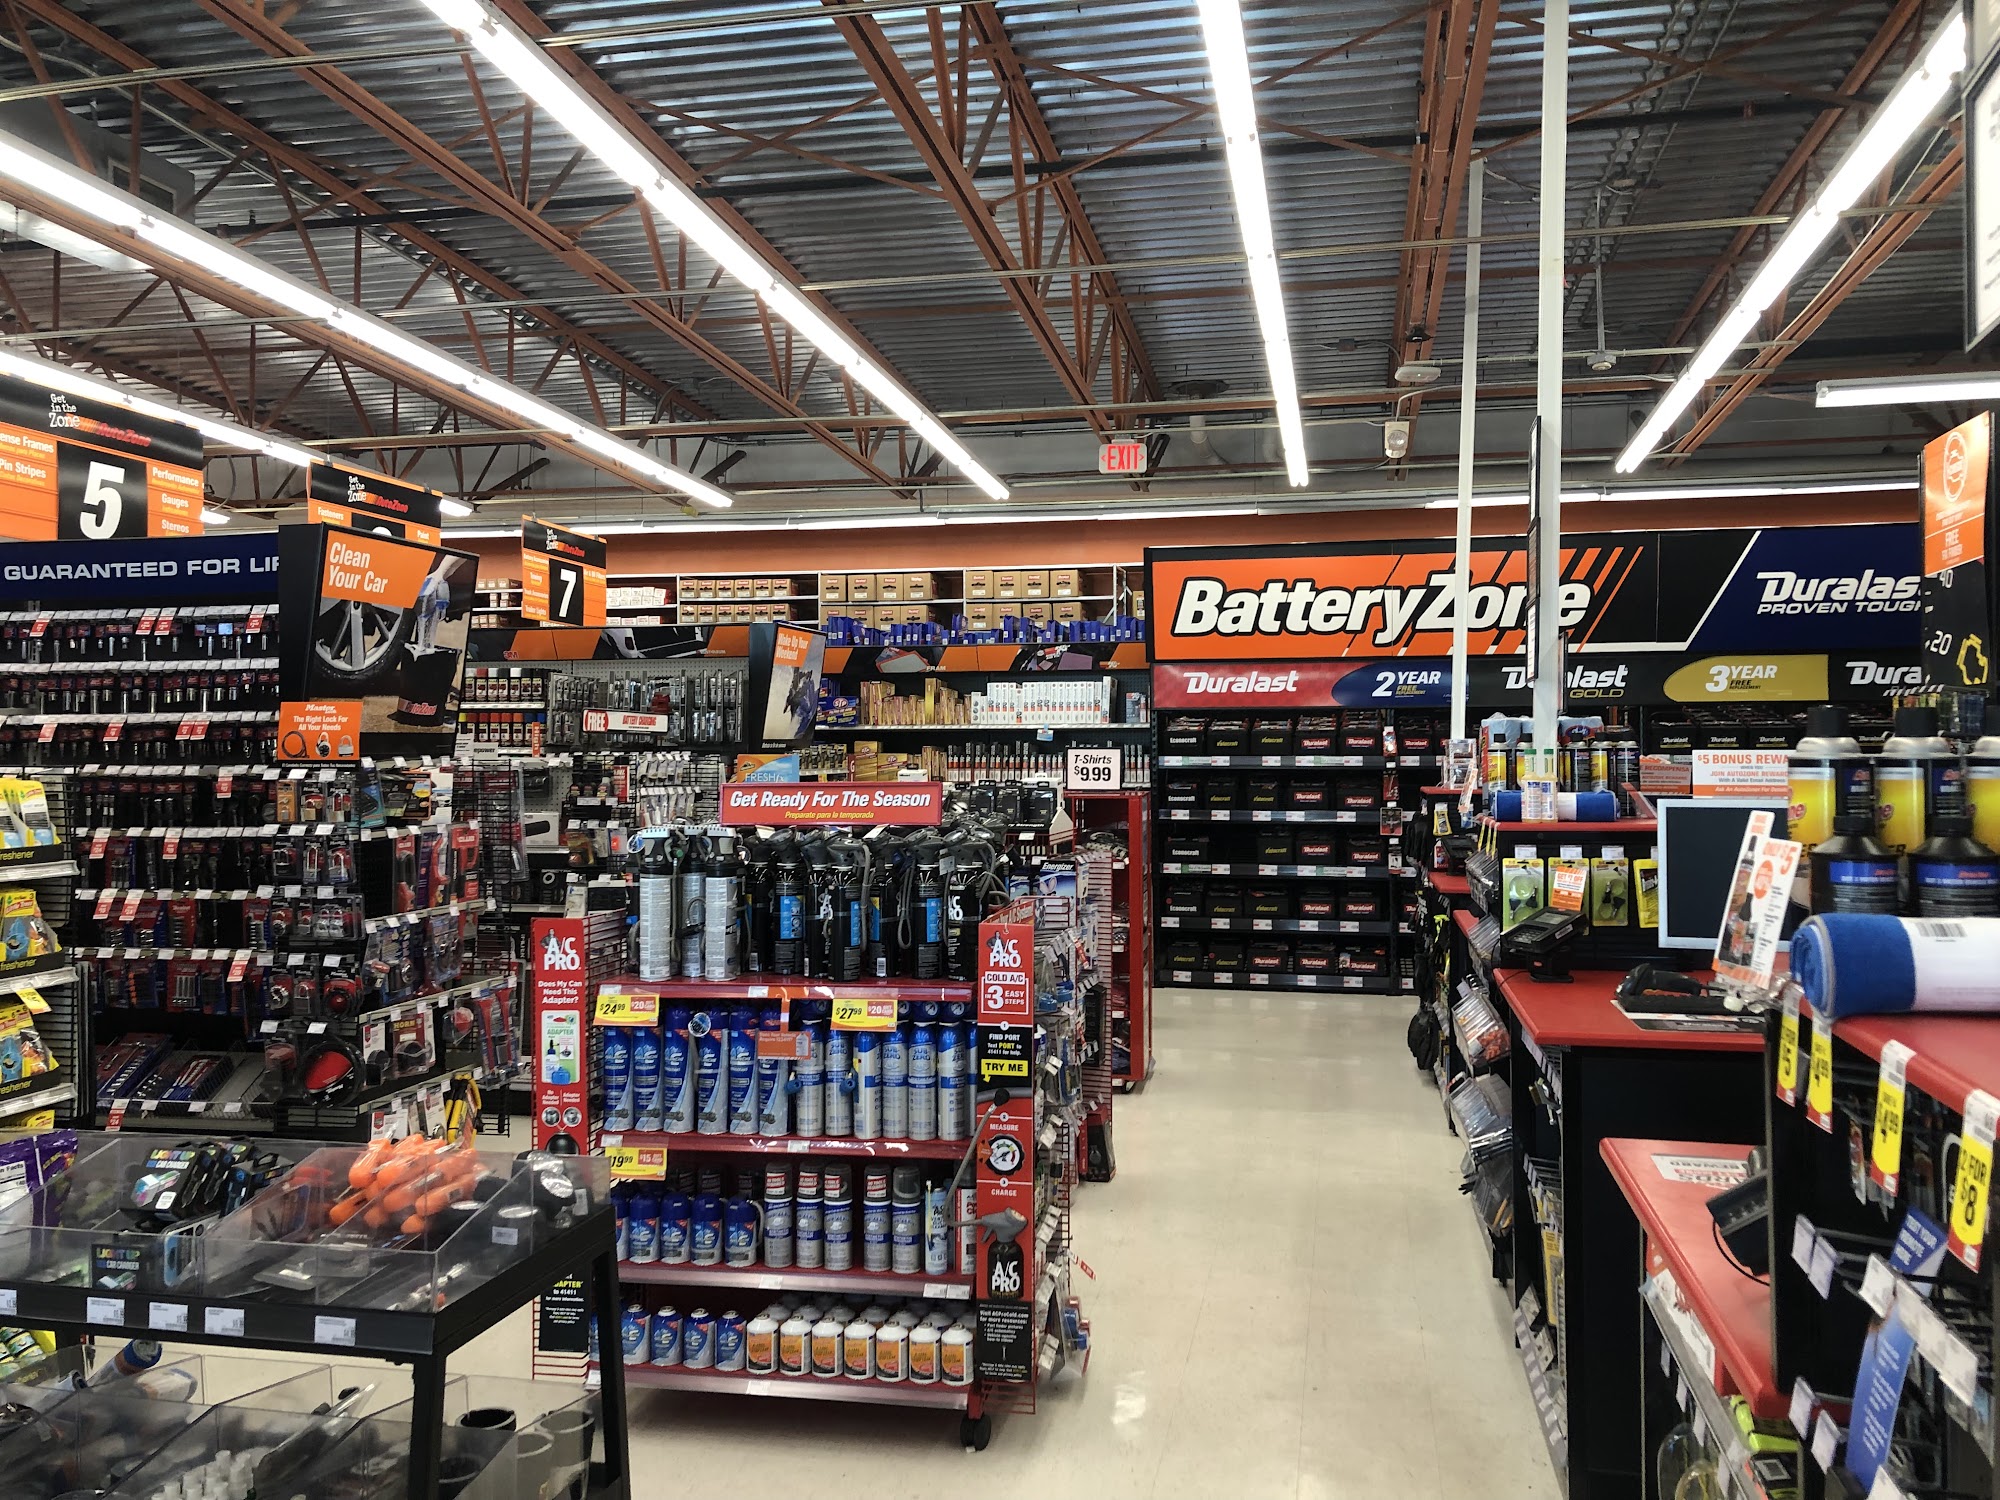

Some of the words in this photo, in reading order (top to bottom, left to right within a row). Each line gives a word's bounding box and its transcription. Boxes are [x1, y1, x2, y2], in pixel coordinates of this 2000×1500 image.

[51, 394, 66, 404] Get
[51, 403, 61, 412] in
[63, 404, 77, 412] the
[49, 413, 80, 427] Zone
[23, 436, 54, 453] Frames
[1107, 445, 1141, 470] EXIT
[0, 458, 13, 471] Pin
[15, 462, 47, 478] Stripes
[152, 466, 199, 487] Performance
[79, 461, 125, 539] 5
[162, 493, 189, 509] Gauges
[348, 490, 367, 502] Zone
[318, 507, 344, 520] Fasteners
[162, 519, 189, 534] Stereos
[330, 541, 371, 569] Clean
[4, 561, 178, 581] GUARANTEED
[187, 559, 240, 575] FOR
[1939, 569, 1953, 588] 40
[328, 568, 361, 591] Your
[363, 574, 389, 595] Car
[1756, 569, 1921, 602] Duralas
[559, 568, 577, 617] 7
[1172, 573, 1592, 645] BatteryZone
[1757, 602, 1848, 615] PROVEN
[1930, 630, 1953, 655] 20
[1183, 670, 1300, 694] Duralast
[1372, 671, 1396, 697] 2
[1398, 671, 1441, 685] YEAR
[1501, 664, 1628, 689] Dlast
[1705, 665, 1731, 692] 3
[1731, 665, 1777, 679] YEAR
[1569, 688, 1624, 698] GOLD
[305, 716, 322, 724] Right
[587, 712, 606, 731] FREE
[1074, 754, 1112, 765] T-Shirts
[1698, 754, 1709, 764] $5
[1712, 754, 1752, 764] BONUS
[1074, 765, 1112, 782] $9.99
[731, 791, 758, 807] Get
[760, 791, 811, 811] Ready
[811, 791, 839, 807] For
[841, 791, 869, 807] The
[872, 791, 931, 807] Season
[839, 811, 874, 819] temporada
[1042, 861, 1074, 871] Energizer
[547, 937, 577, 954] A/C
[993, 939, 1018, 954] A/C
[544, 953, 580, 970] PRO
[990, 952, 1021, 967] PRO
[987, 973, 1007, 981] COLD
[1010, 974, 1023, 983] A/C
[987, 985, 1004, 1009] 3
[985, 1062, 1005, 1071] TRY
[1008, 1063, 1023, 1072] ME
[990, 1123, 1019, 1131] MEASURE
[1968, 1159, 1987, 1186] FOR
[994, 1261, 1018, 1278] A/C
[992, 1275, 1020, 1292] PRO
